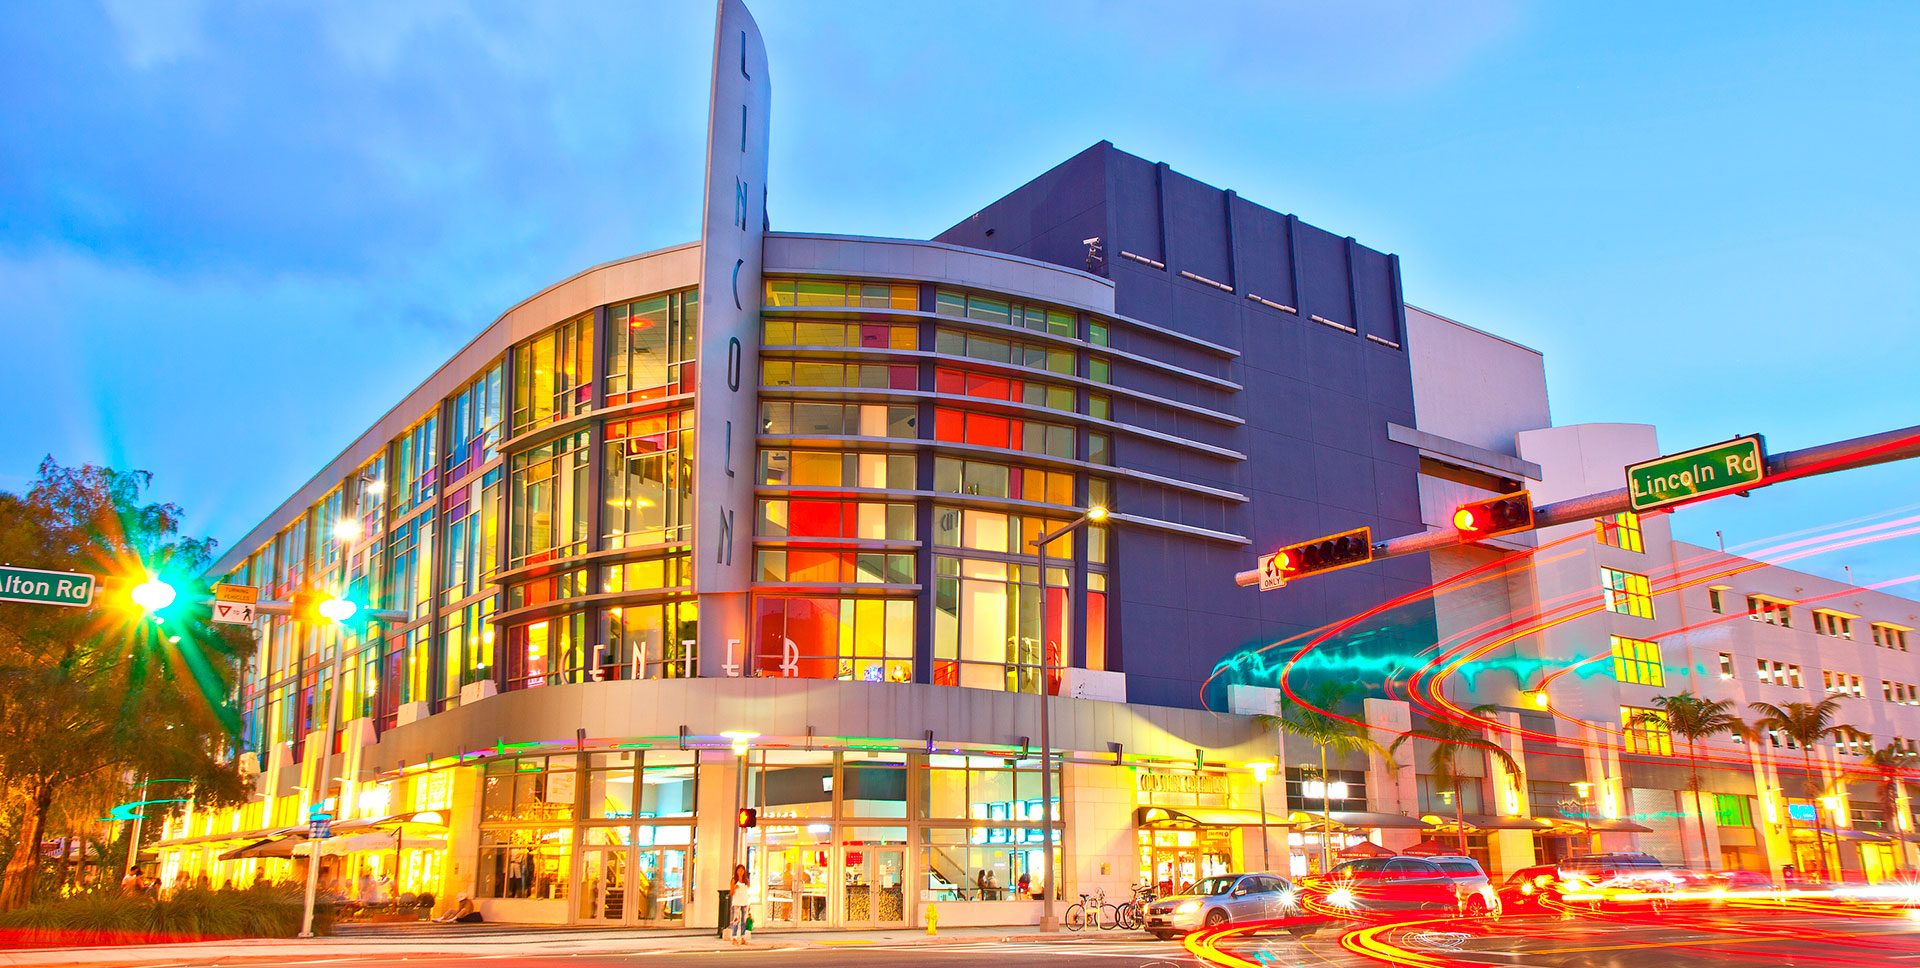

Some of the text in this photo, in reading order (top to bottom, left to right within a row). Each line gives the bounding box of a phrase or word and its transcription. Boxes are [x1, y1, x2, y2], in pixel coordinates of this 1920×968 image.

[716, 30, 750, 566] LINCOLN
[1633, 450, 1757, 498] Lincoln Rd
[0, 575, 87, 599] lton Rd
[1264, 577, 1280, 587] ONLY
[559, 637, 799, 685] CENTER
